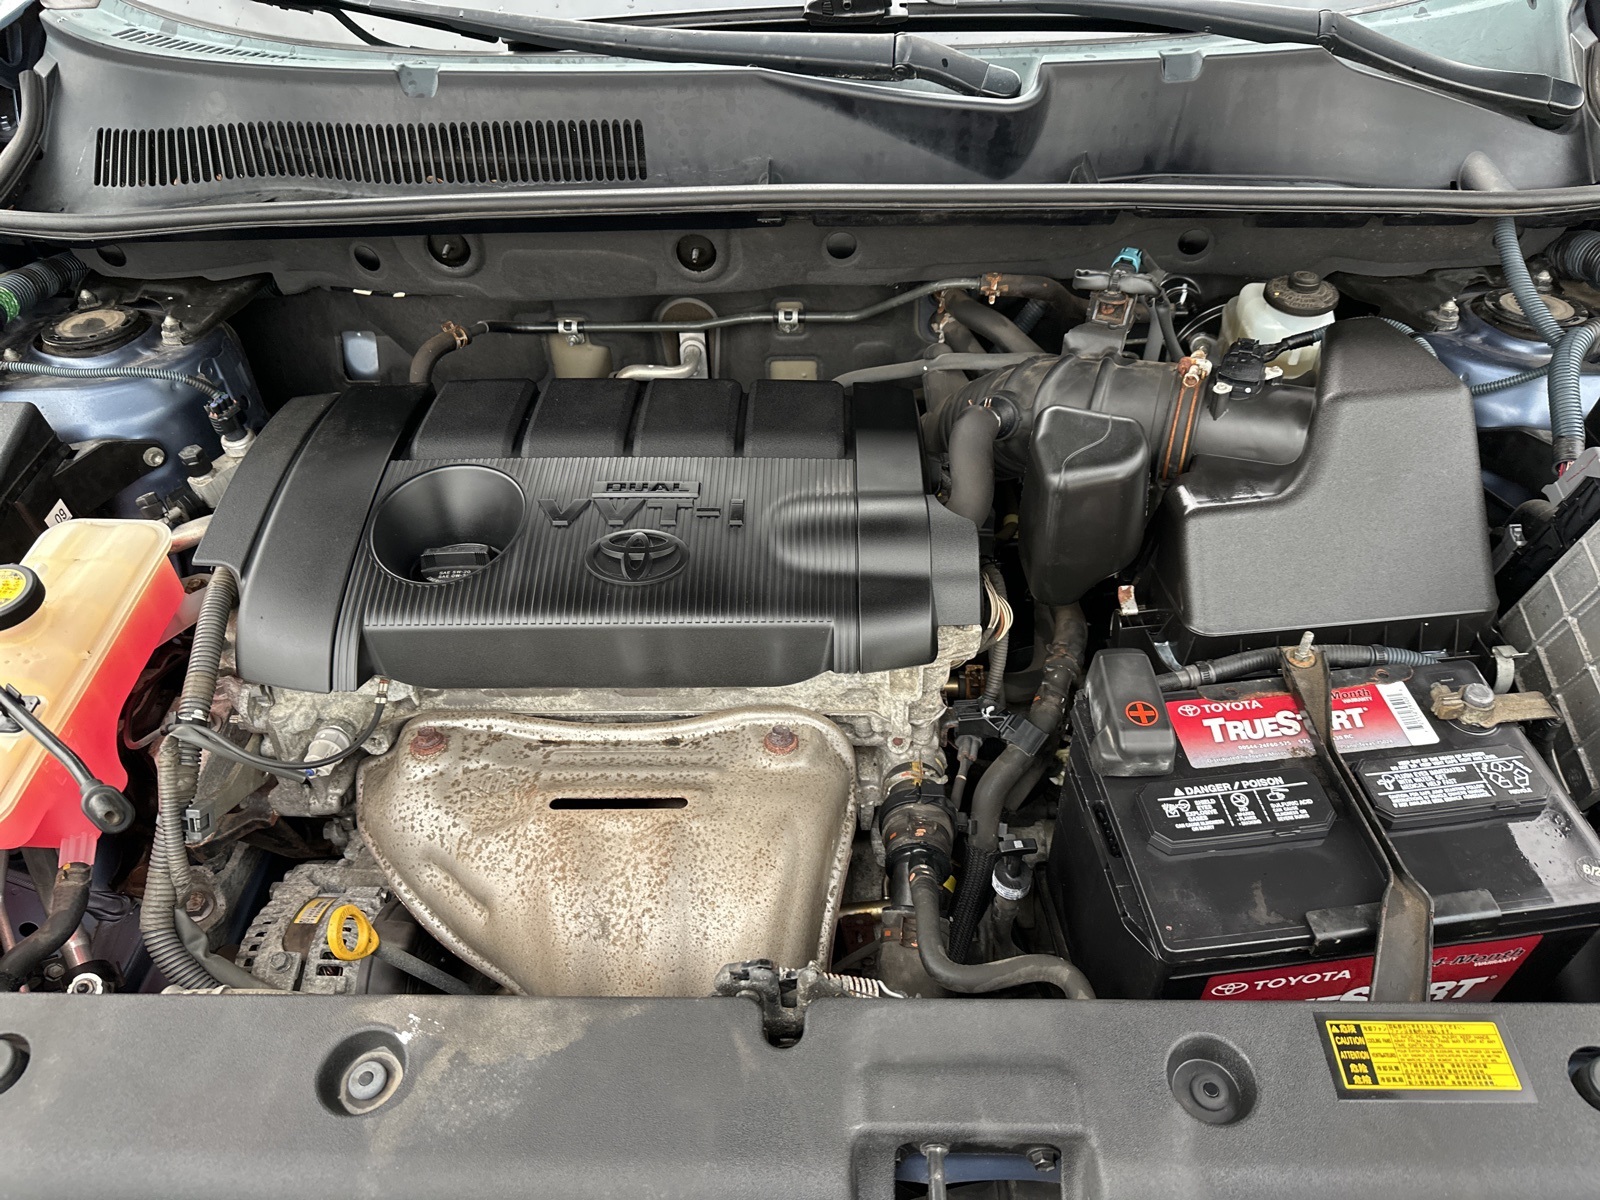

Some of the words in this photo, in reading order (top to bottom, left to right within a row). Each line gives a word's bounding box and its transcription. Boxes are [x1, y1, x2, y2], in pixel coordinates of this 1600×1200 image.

[606, 482, 690, 492] DUAL
[1200, 700, 1264, 714] TOYOTA
[1184, 782, 1232, 796] DANGER
[1241, 776, 1284, 788] POISON
[1254, 970, 1351, 990] TOYOTA
[1335, 1036, 1365, 1045] CAUTION
[1341, 1051, 1370, 1060] ATTENTION
